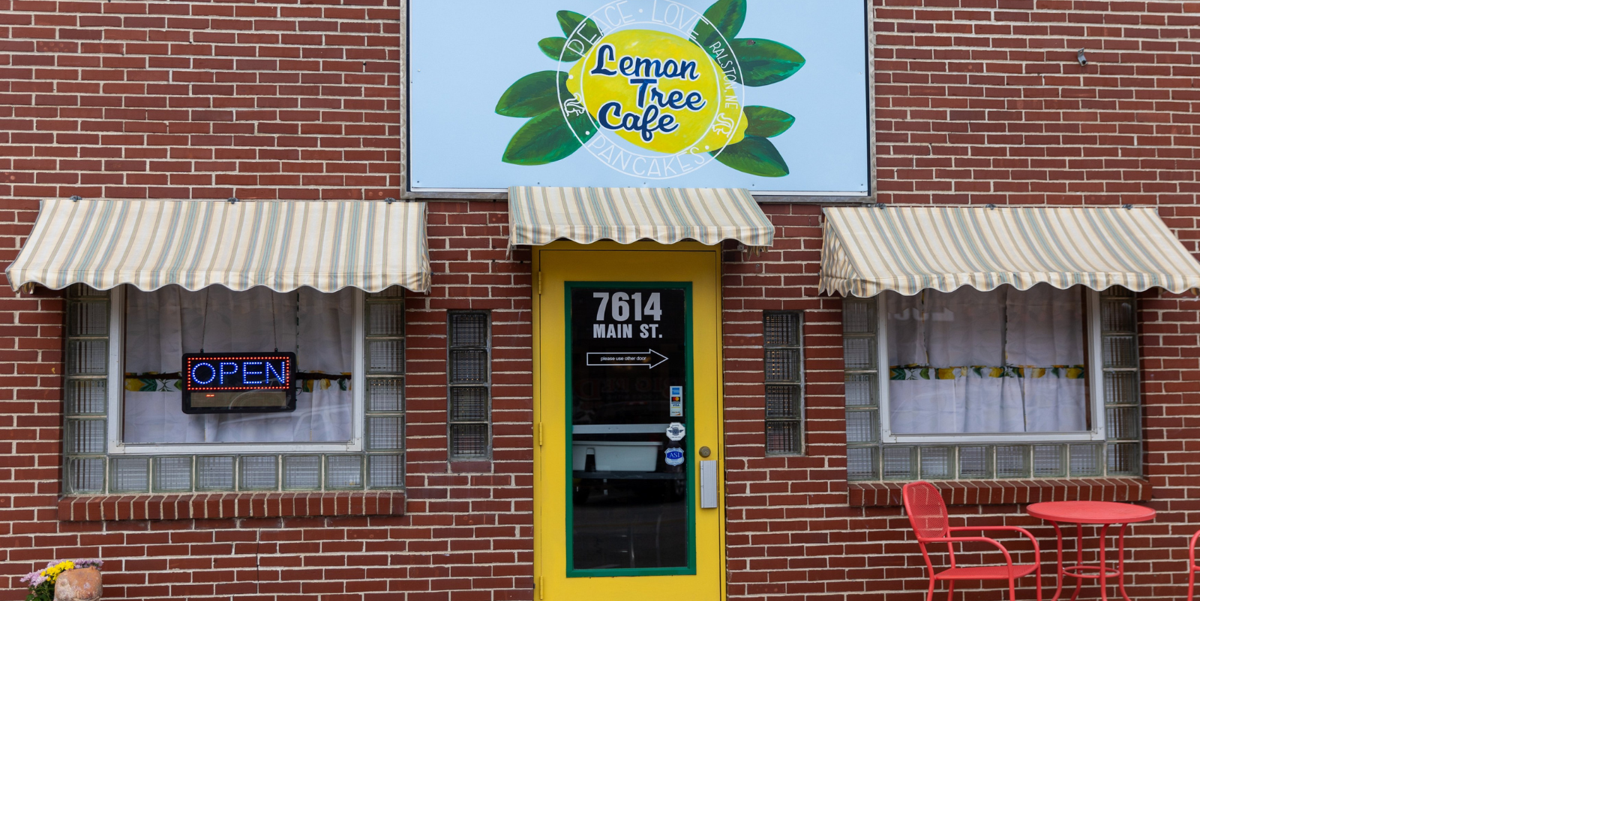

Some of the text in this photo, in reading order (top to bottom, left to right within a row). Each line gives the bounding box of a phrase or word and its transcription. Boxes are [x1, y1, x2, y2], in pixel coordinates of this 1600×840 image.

[566, 0, 709, 58] PEACE LOVE
[590, 45, 699, 80] Lemon
[630, 78, 706, 111] Tree
[725, 95, 739, 109] NE
[597, 102, 679, 142] Cafe
[587, 139, 706, 177] PANCAKES
[593, 292, 662, 321] 7614
[593, 324, 663, 338] MAIN ST.
[192, 362, 285, 384] OPEN
